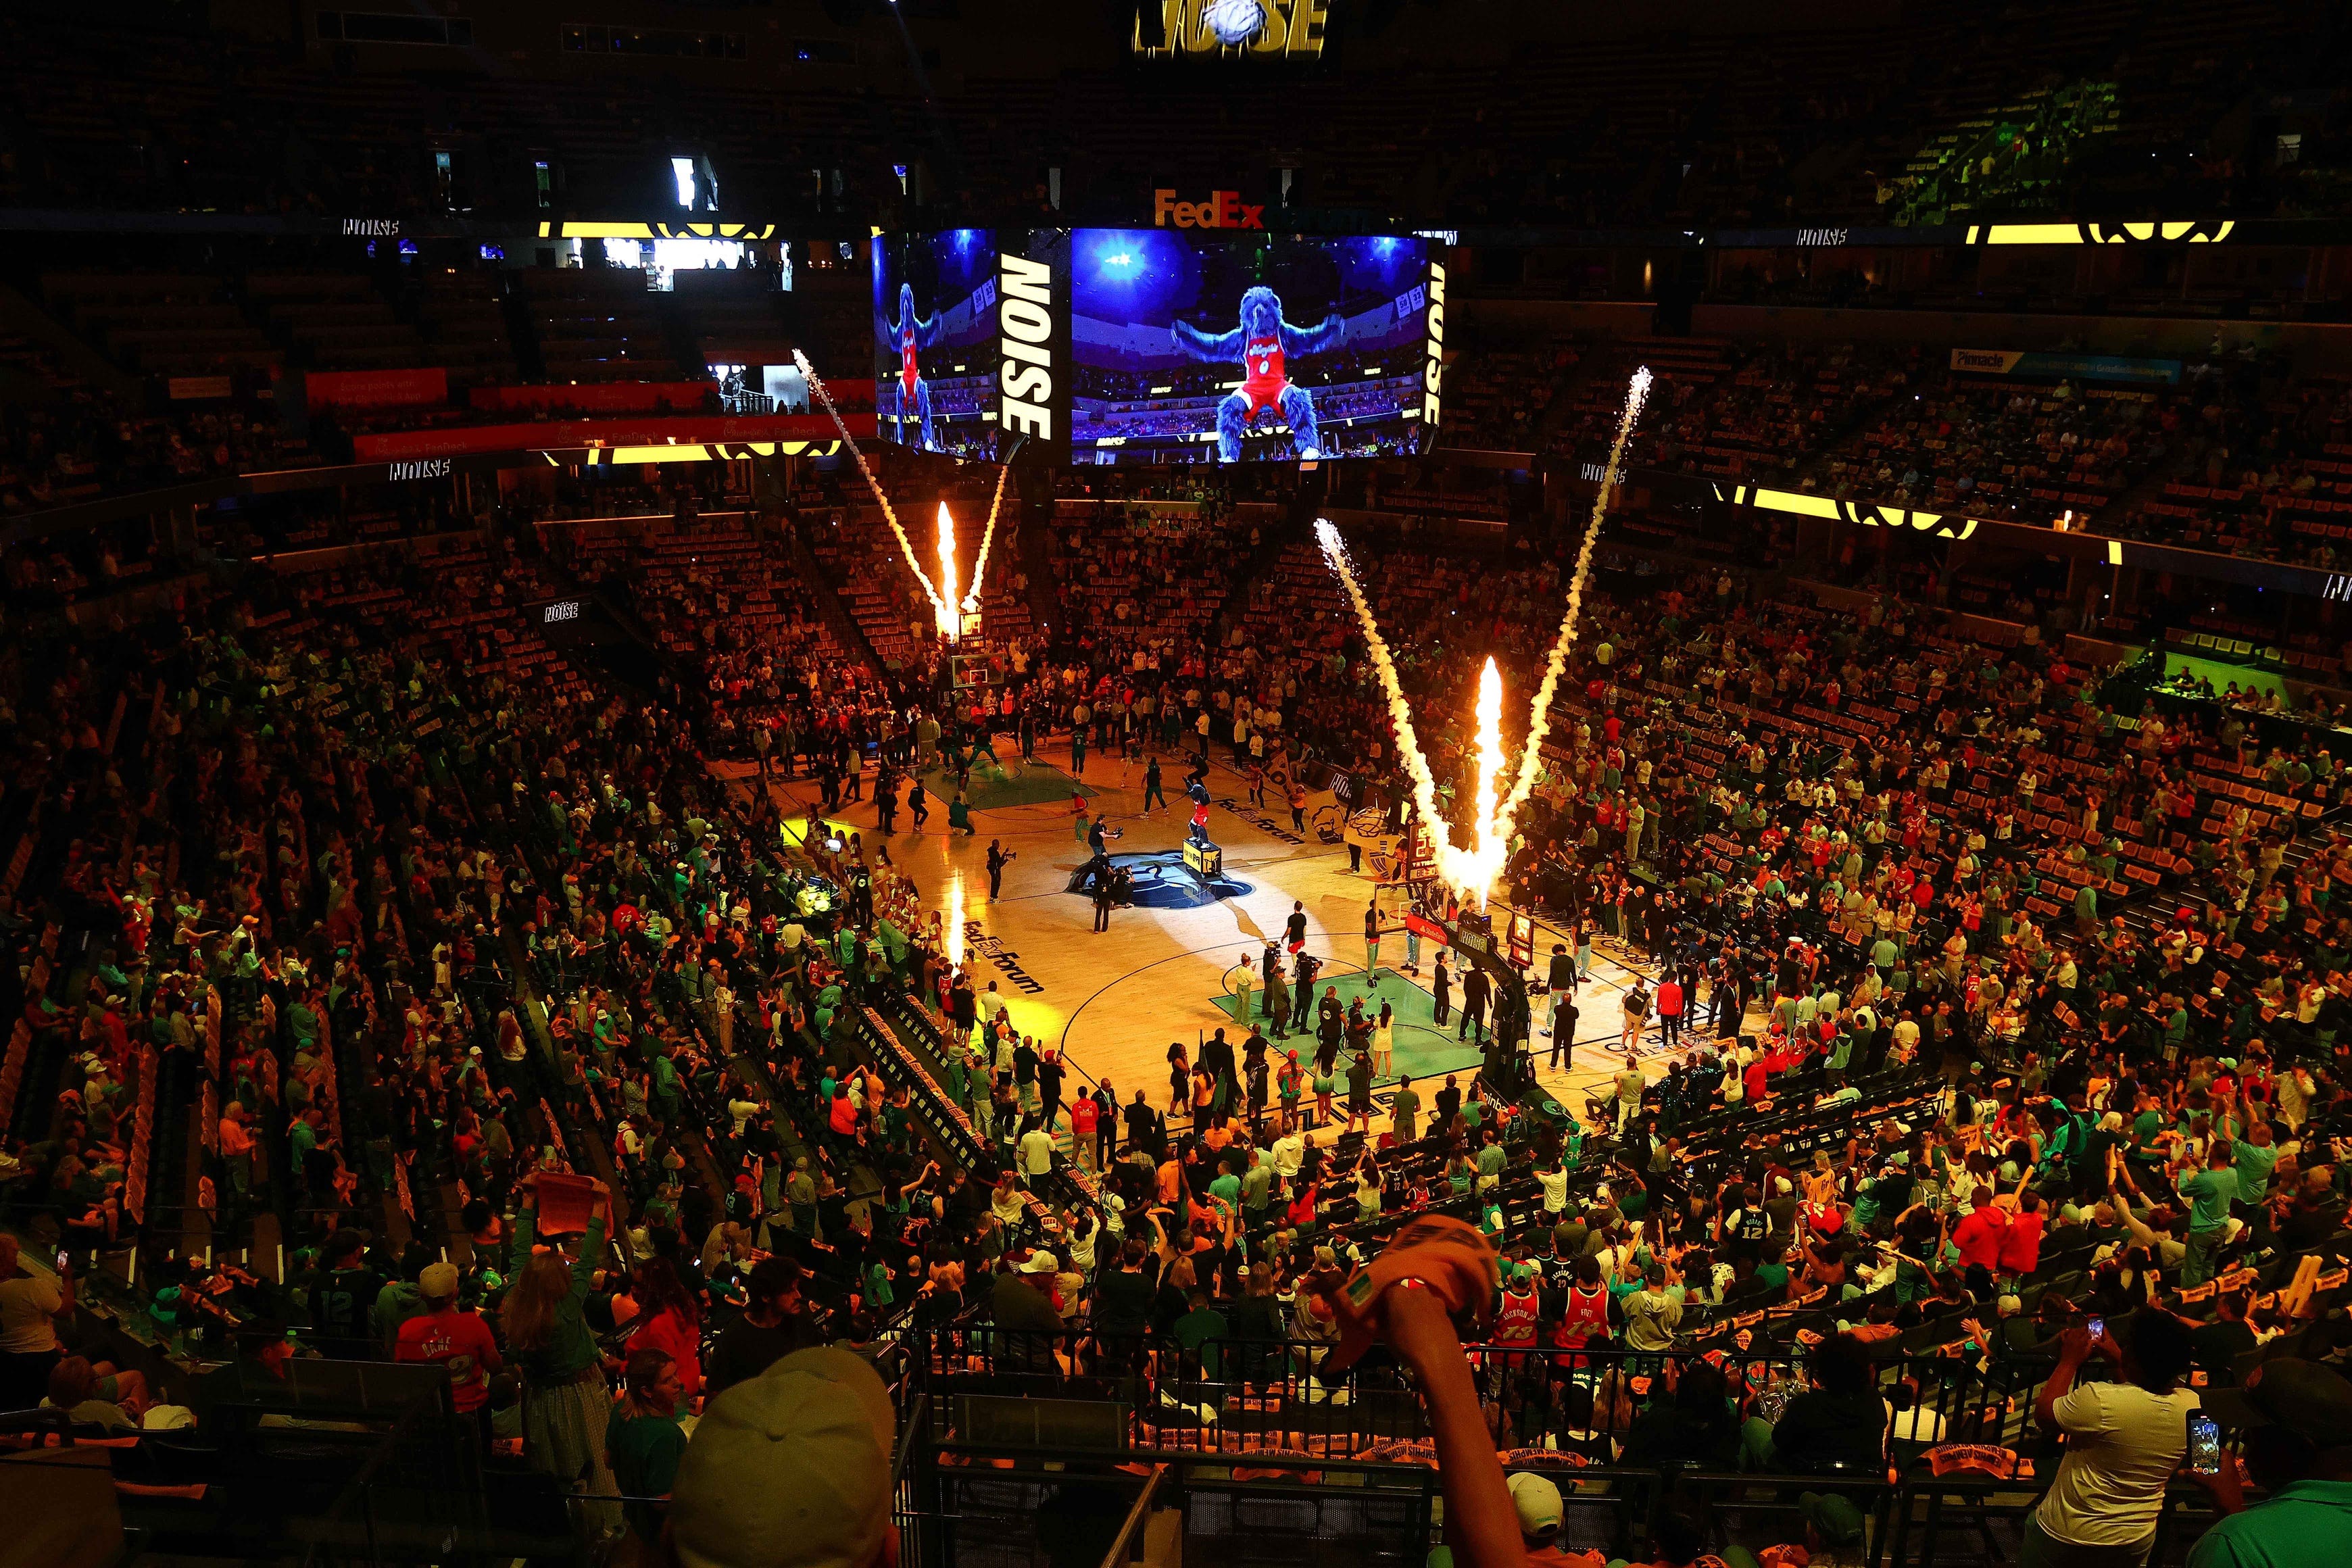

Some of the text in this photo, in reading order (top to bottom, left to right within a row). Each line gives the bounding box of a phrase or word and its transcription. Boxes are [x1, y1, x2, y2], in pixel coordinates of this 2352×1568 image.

[1154, 189, 1264, 228] FedEx
[1001, 253, 1052, 440] NOISE
[1424, 262, 1445, 426] NOISE
[545, 602, 579, 622] NOISE
[1461, 930, 1486, 952] NOISE
[1742, 1227, 1763, 1240] 12
[320, 1290, 352, 1323] 12
[1503, 1308, 1527, 1321] JACKSON
[1502, 1325, 1533, 1340] 13
[1567, 1320, 1601, 1338] 14
[1408, 1446, 1438, 1461] EMPHIS
